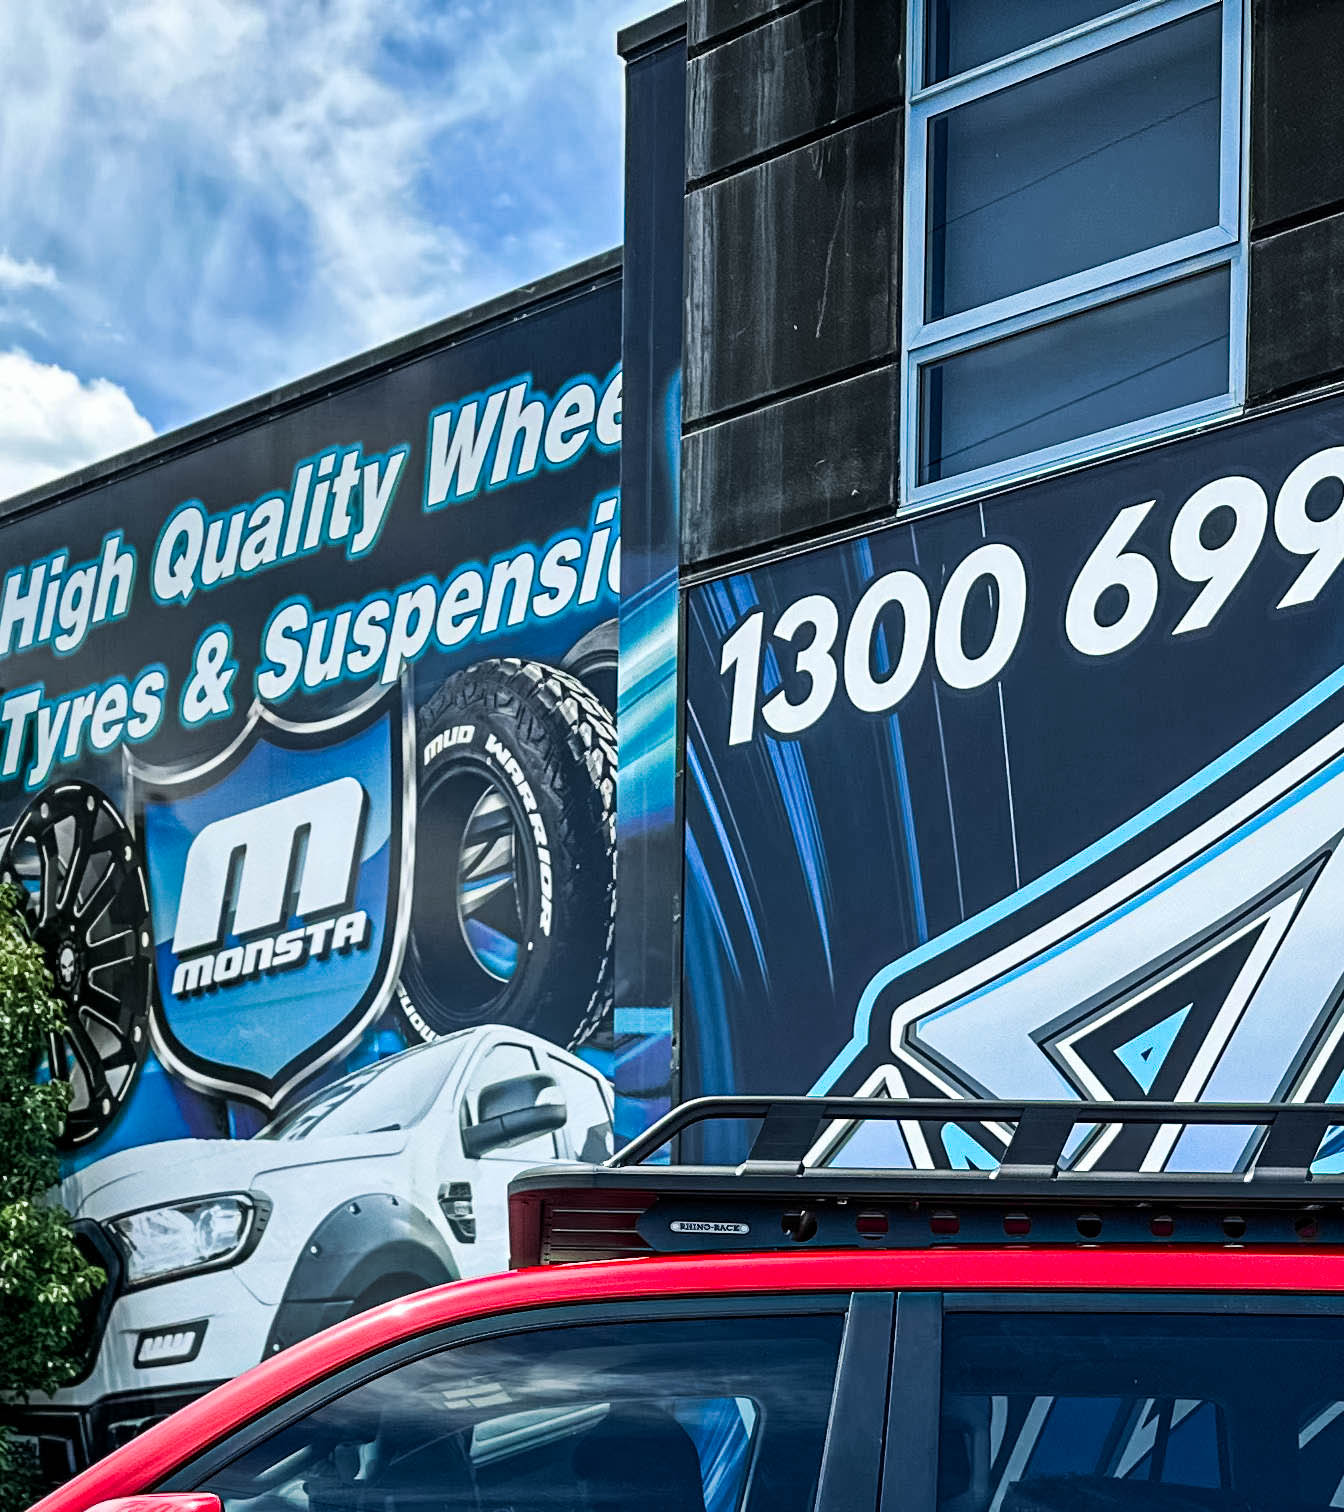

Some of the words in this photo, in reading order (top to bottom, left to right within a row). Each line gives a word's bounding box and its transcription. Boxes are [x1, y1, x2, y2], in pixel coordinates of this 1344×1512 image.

[154, 450, 406, 600] Quality
[1, 671, 165, 786] Tyres
[183, 630, 236, 724] &
[257, 497, 620, 700] Suspensi
[720, 543, 1027, 746] 1300
[423, 724, 476, 767] MUD
[484, 734, 553, 937] WARRIOR
[171, 909, 367, 995] MONSTA
[679, 1222, 740, 1232] RHINO-RACK
